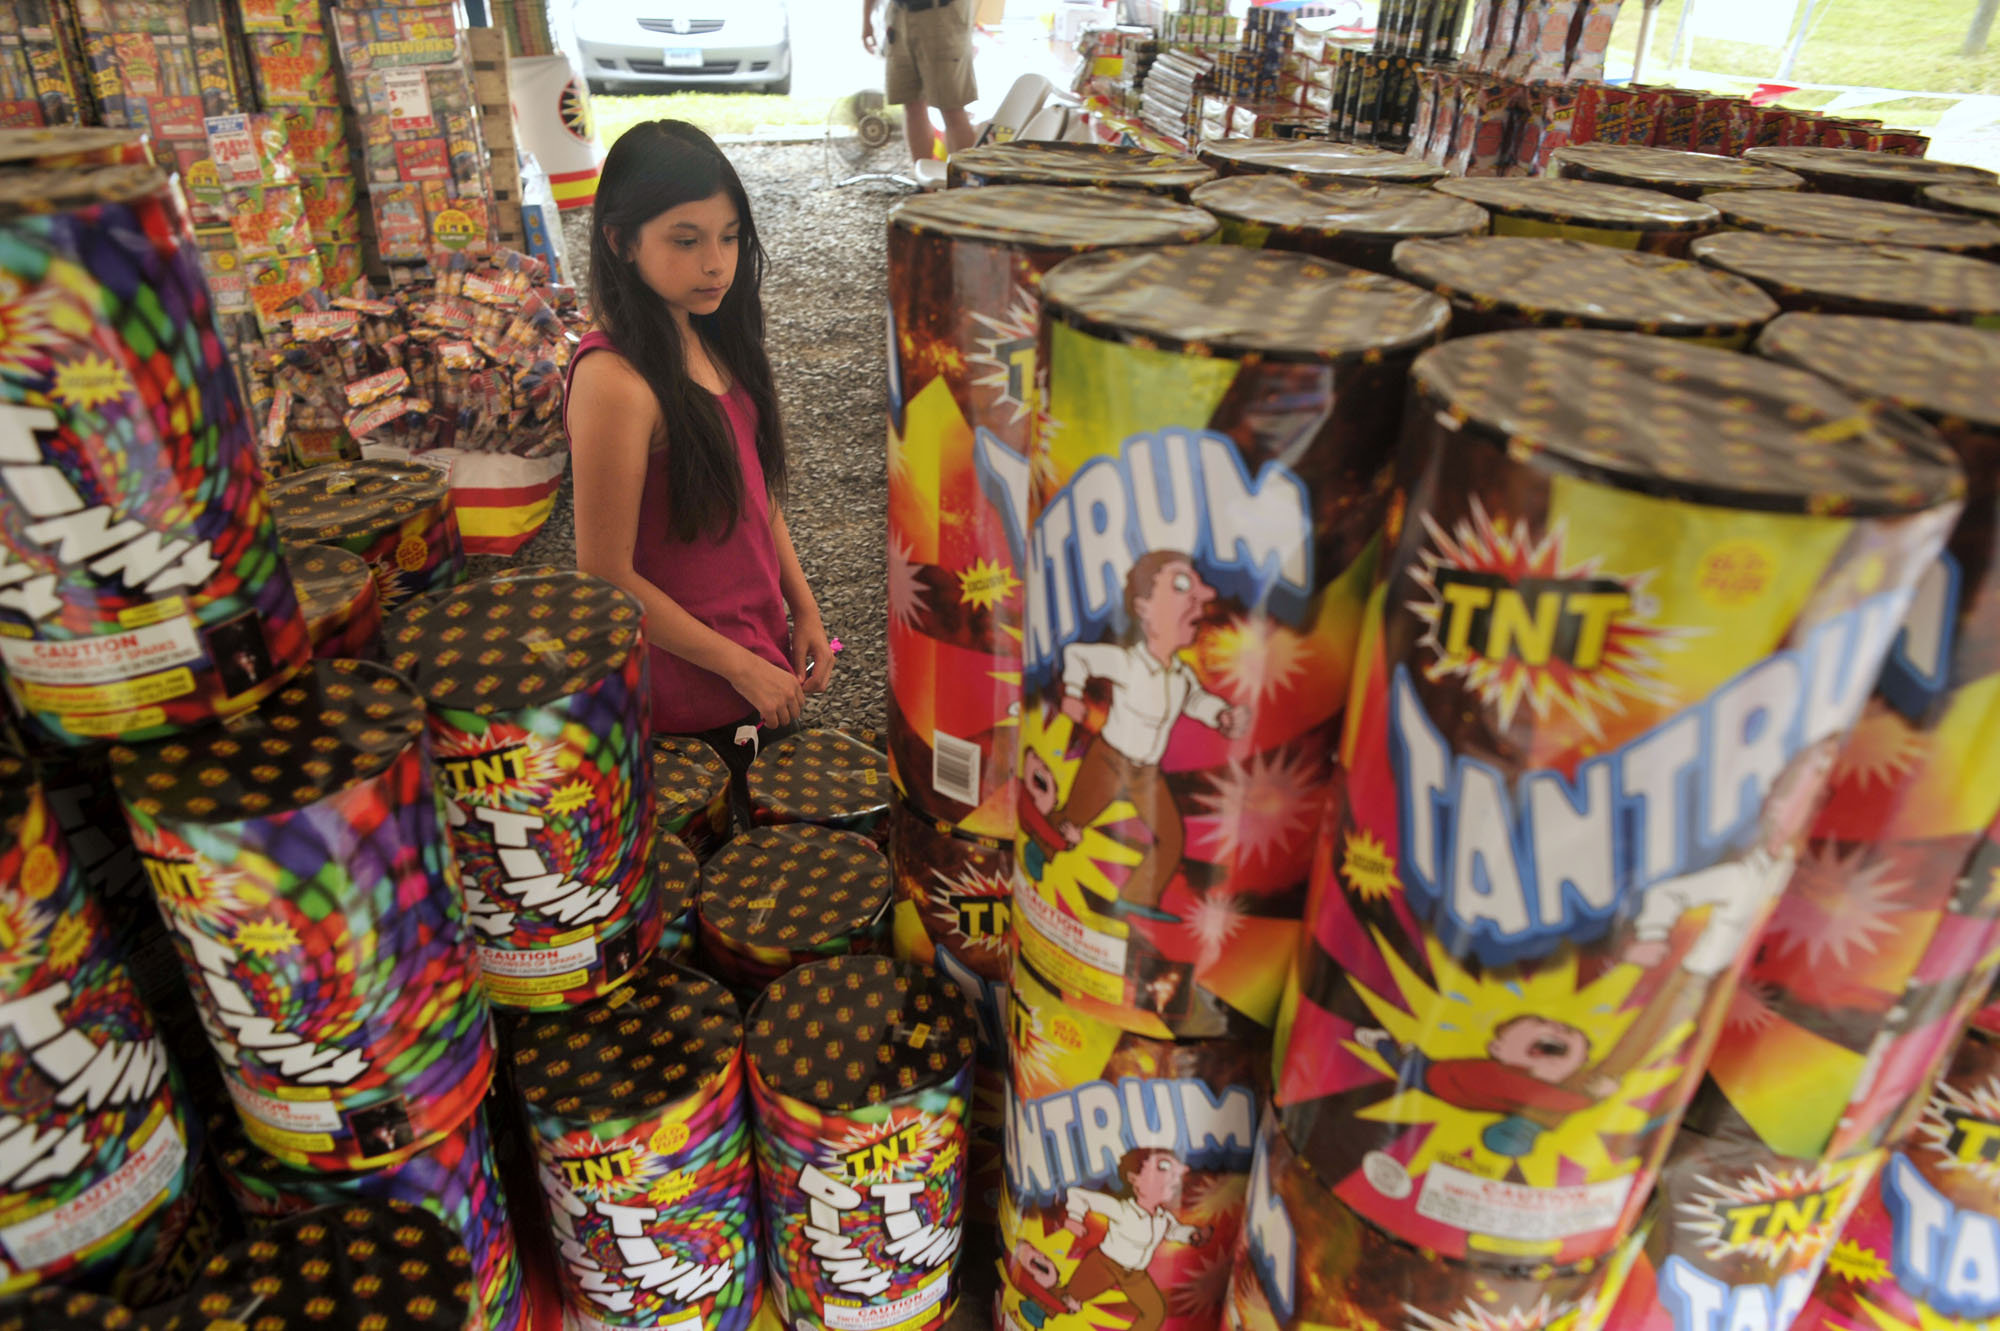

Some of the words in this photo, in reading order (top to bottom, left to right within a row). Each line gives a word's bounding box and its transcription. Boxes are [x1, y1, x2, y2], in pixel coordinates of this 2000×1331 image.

[368, 38, 455, 56] FIREWORKS
[1443, 582, 1630, 669] TNT
[33, 634, 138, 661] CAUTION
[445, 746, 531, 794] TNT
[961, 903, 1011, 937] TN
[562, 1150, 636, 1189] TNT
[847, 1125, 922, 1180] TNT
[54, 1152, 147, 1221] CAUTION
[1727, 1187, 1846, 1242] TNT
[858, 1292, 923, 1316] CAUTION
